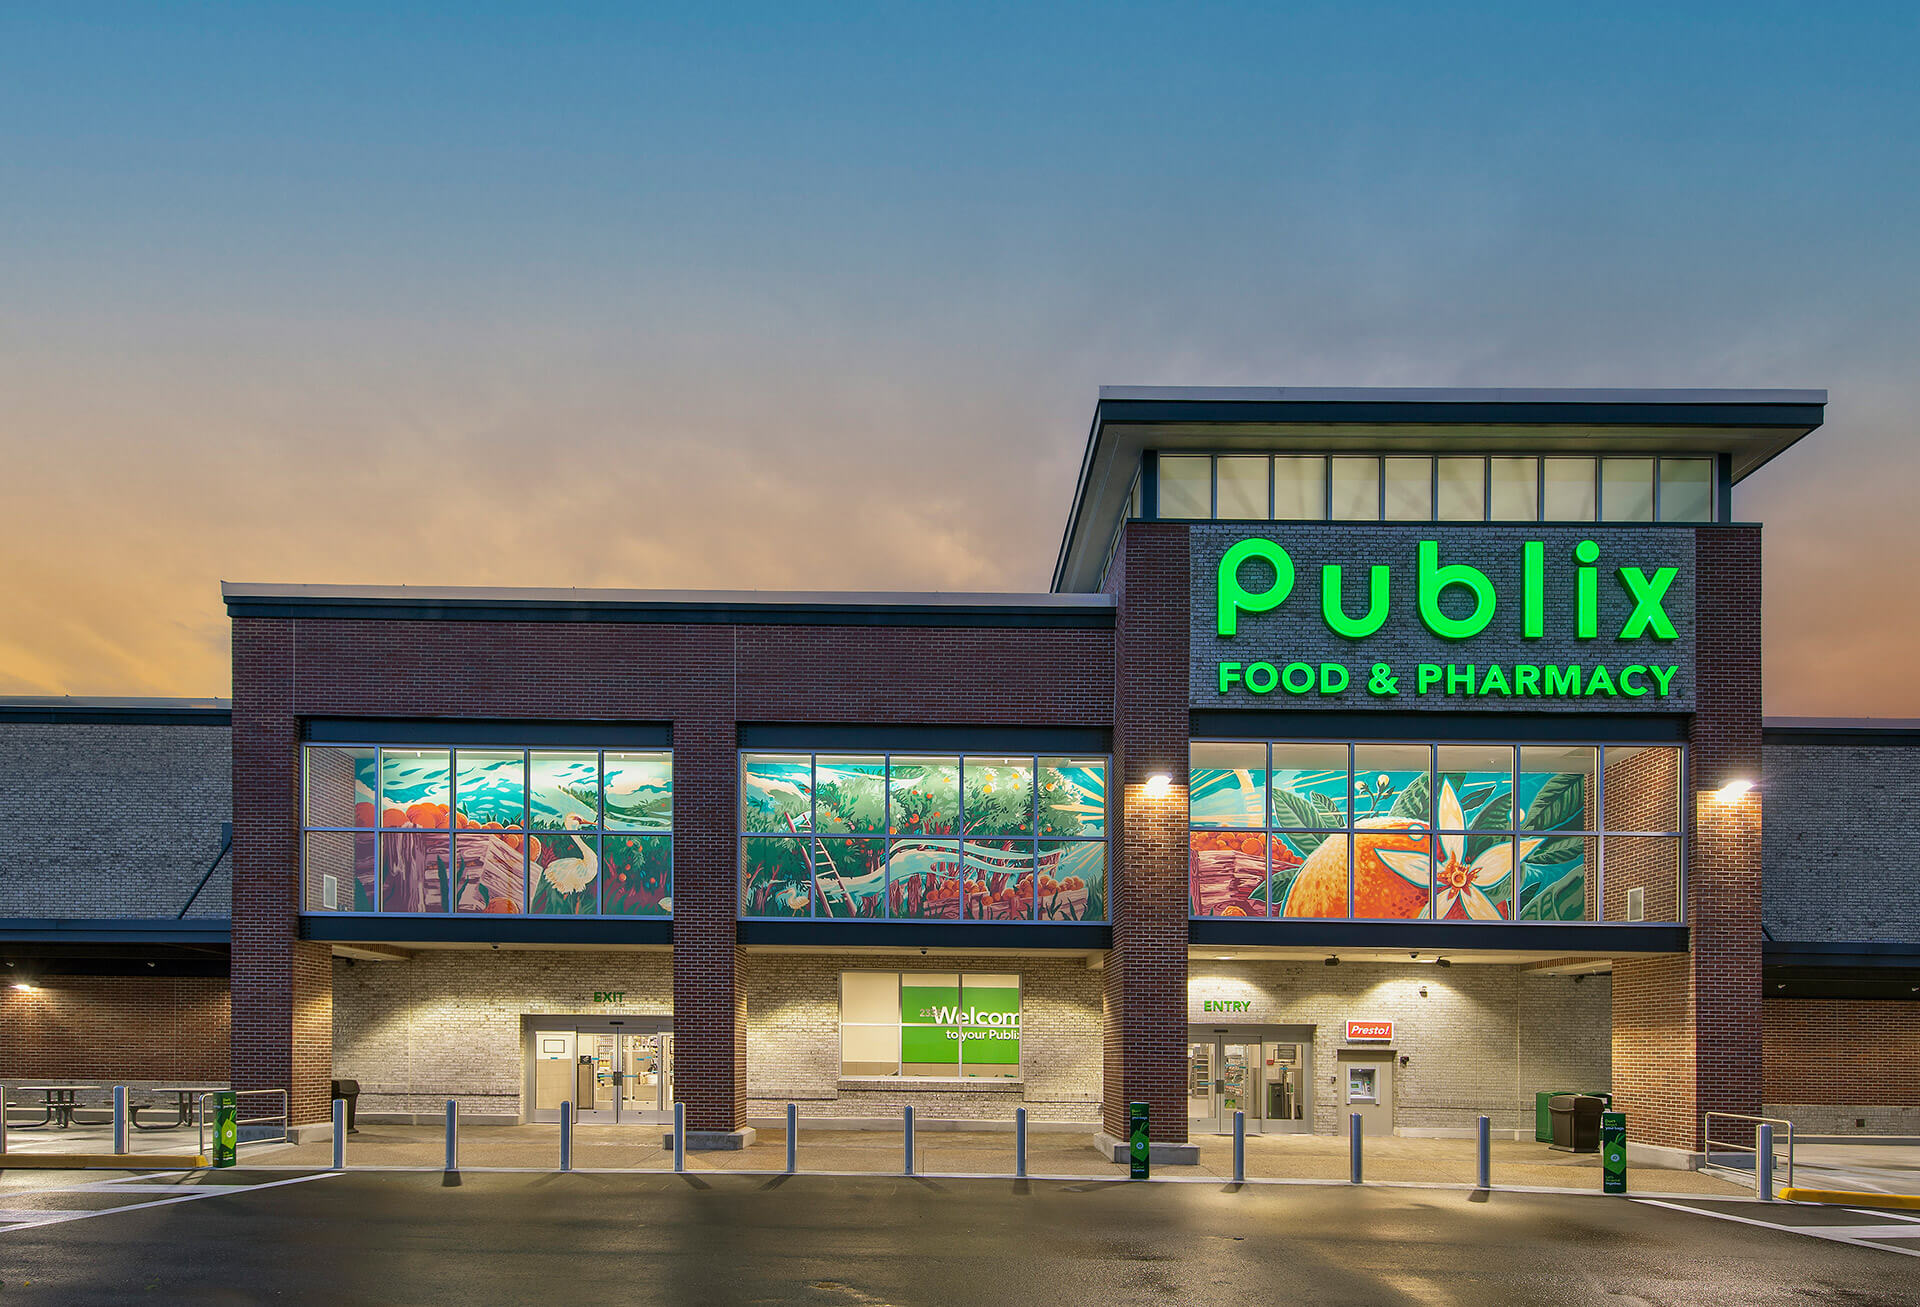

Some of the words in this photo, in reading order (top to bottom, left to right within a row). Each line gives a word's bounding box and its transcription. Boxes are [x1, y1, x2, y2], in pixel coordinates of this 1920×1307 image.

[1218, 538, 1679, 638] Publix
[1220, 662, 1349, 693] FOOD
[1368, 663, 1399, 694] &
[1419, 664, 1679, 696] PHARMACY
[593, 991, 625, 1003] EXIT
[1203, 1000, 1251, 1012] ENTRY
[932, 1006, 1019, 1025] Welcom
[945, 1029, 959, 1039] to
[961, 1031, 987, 1042] your
[1350, 1025, 1390, 1035] Presto!
